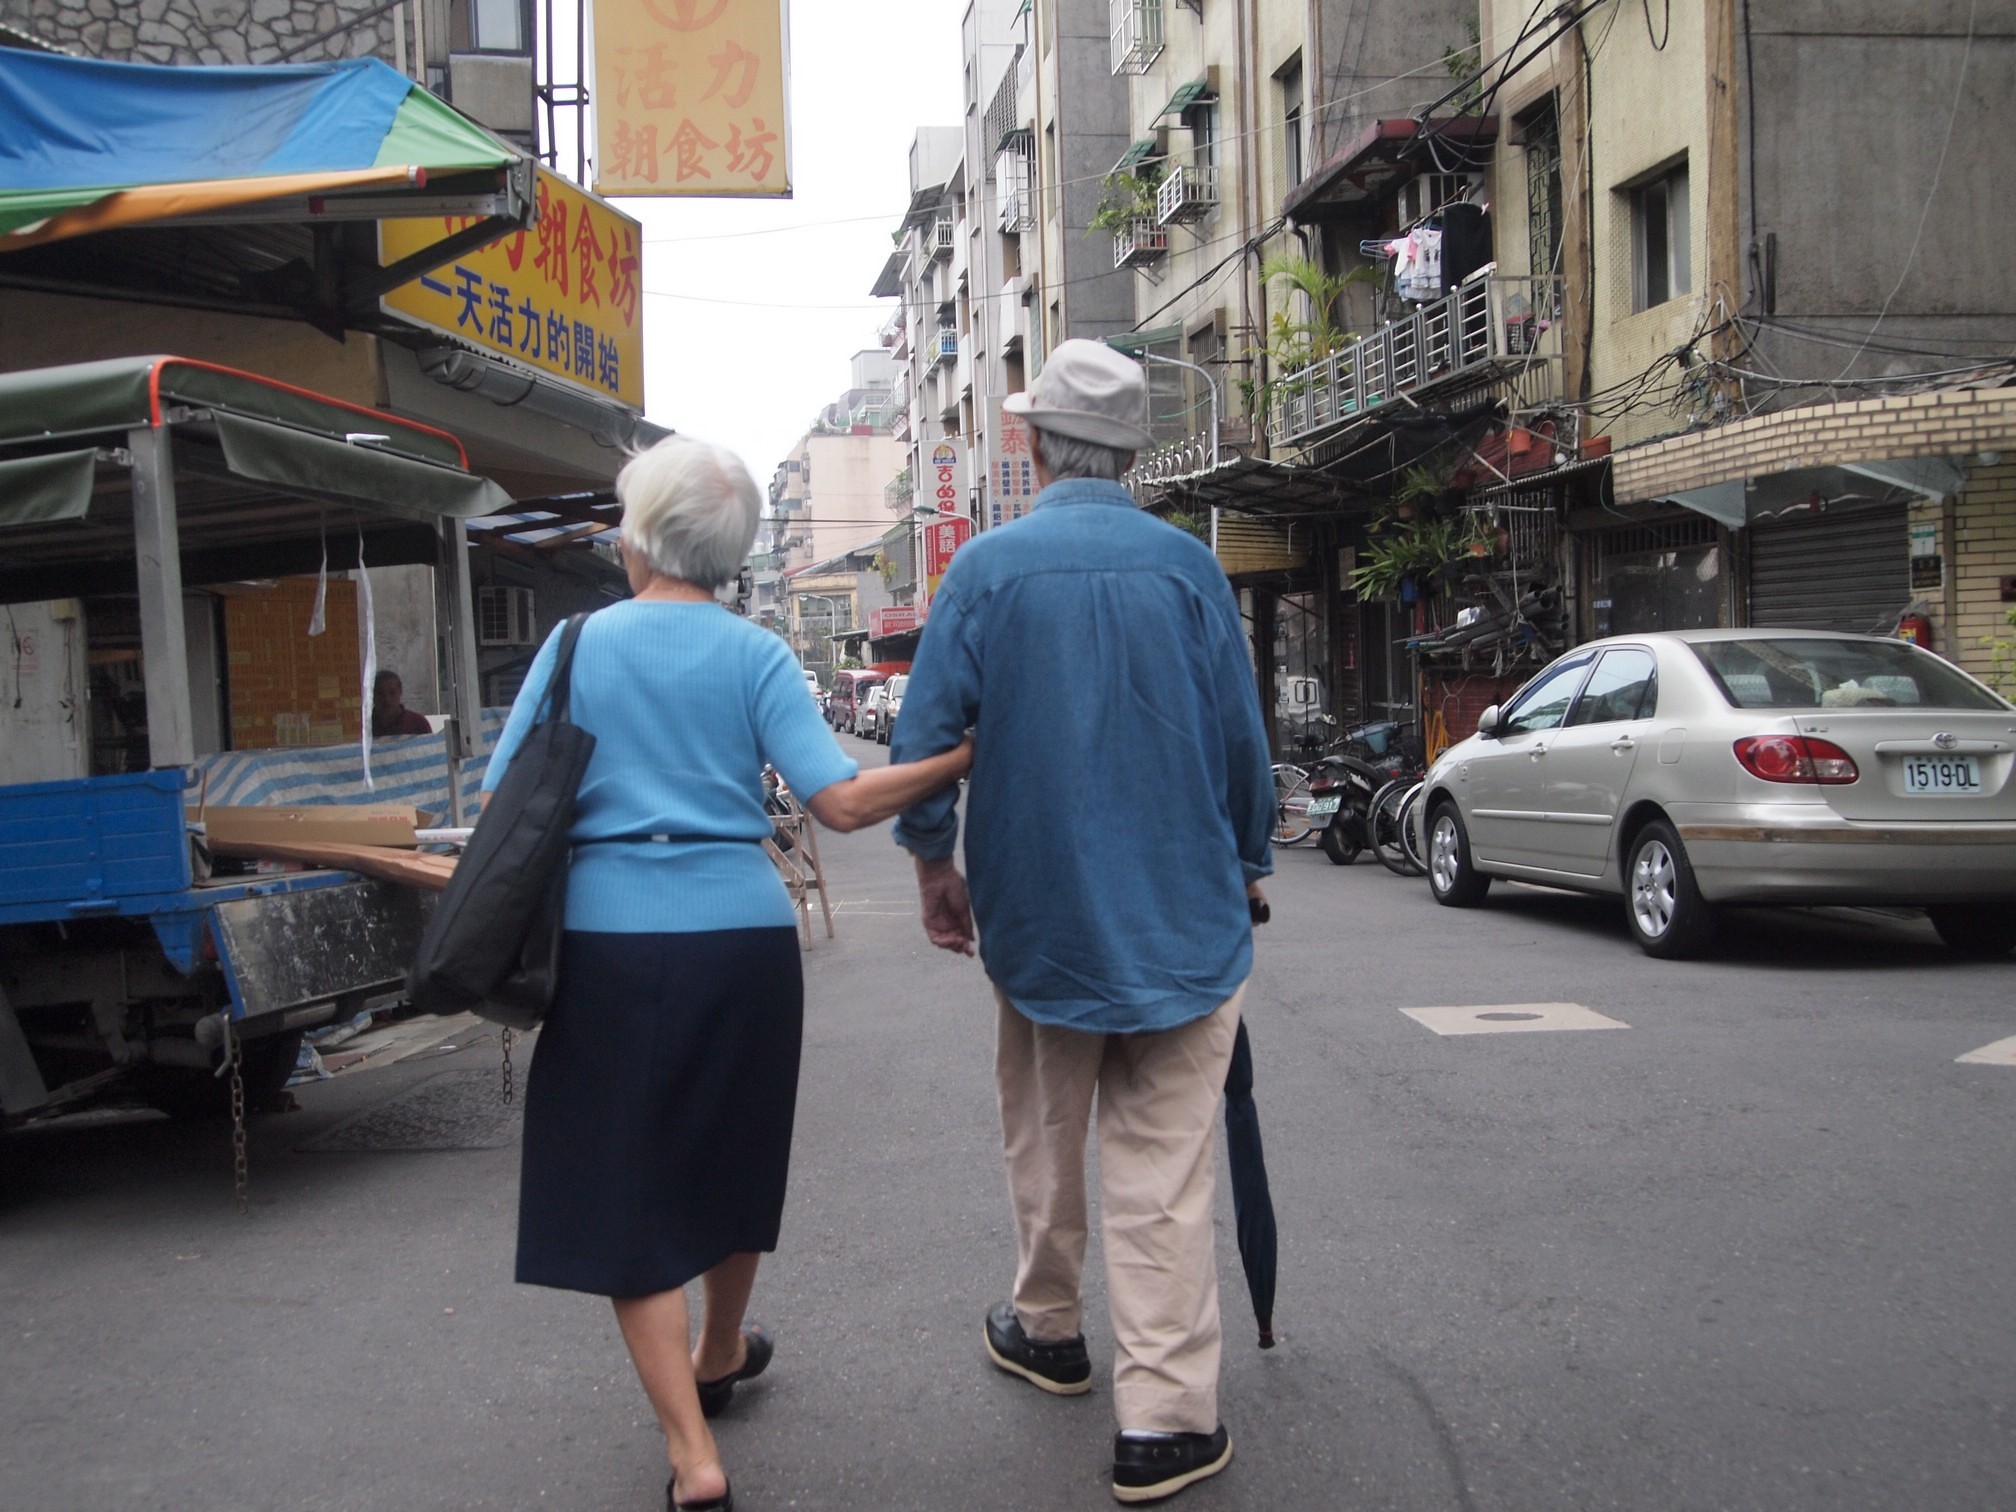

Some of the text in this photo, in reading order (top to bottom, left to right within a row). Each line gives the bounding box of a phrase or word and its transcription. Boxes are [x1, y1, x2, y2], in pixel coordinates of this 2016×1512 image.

[616, 39, 761, 110] 活力
[605, 116, 779, 183] 朝食坊
[420, 264, 620, 393] 一天活力的開始
[938, 524, 956, 553] 美語
[1907, 763, 1979, 787] 1519-DL
